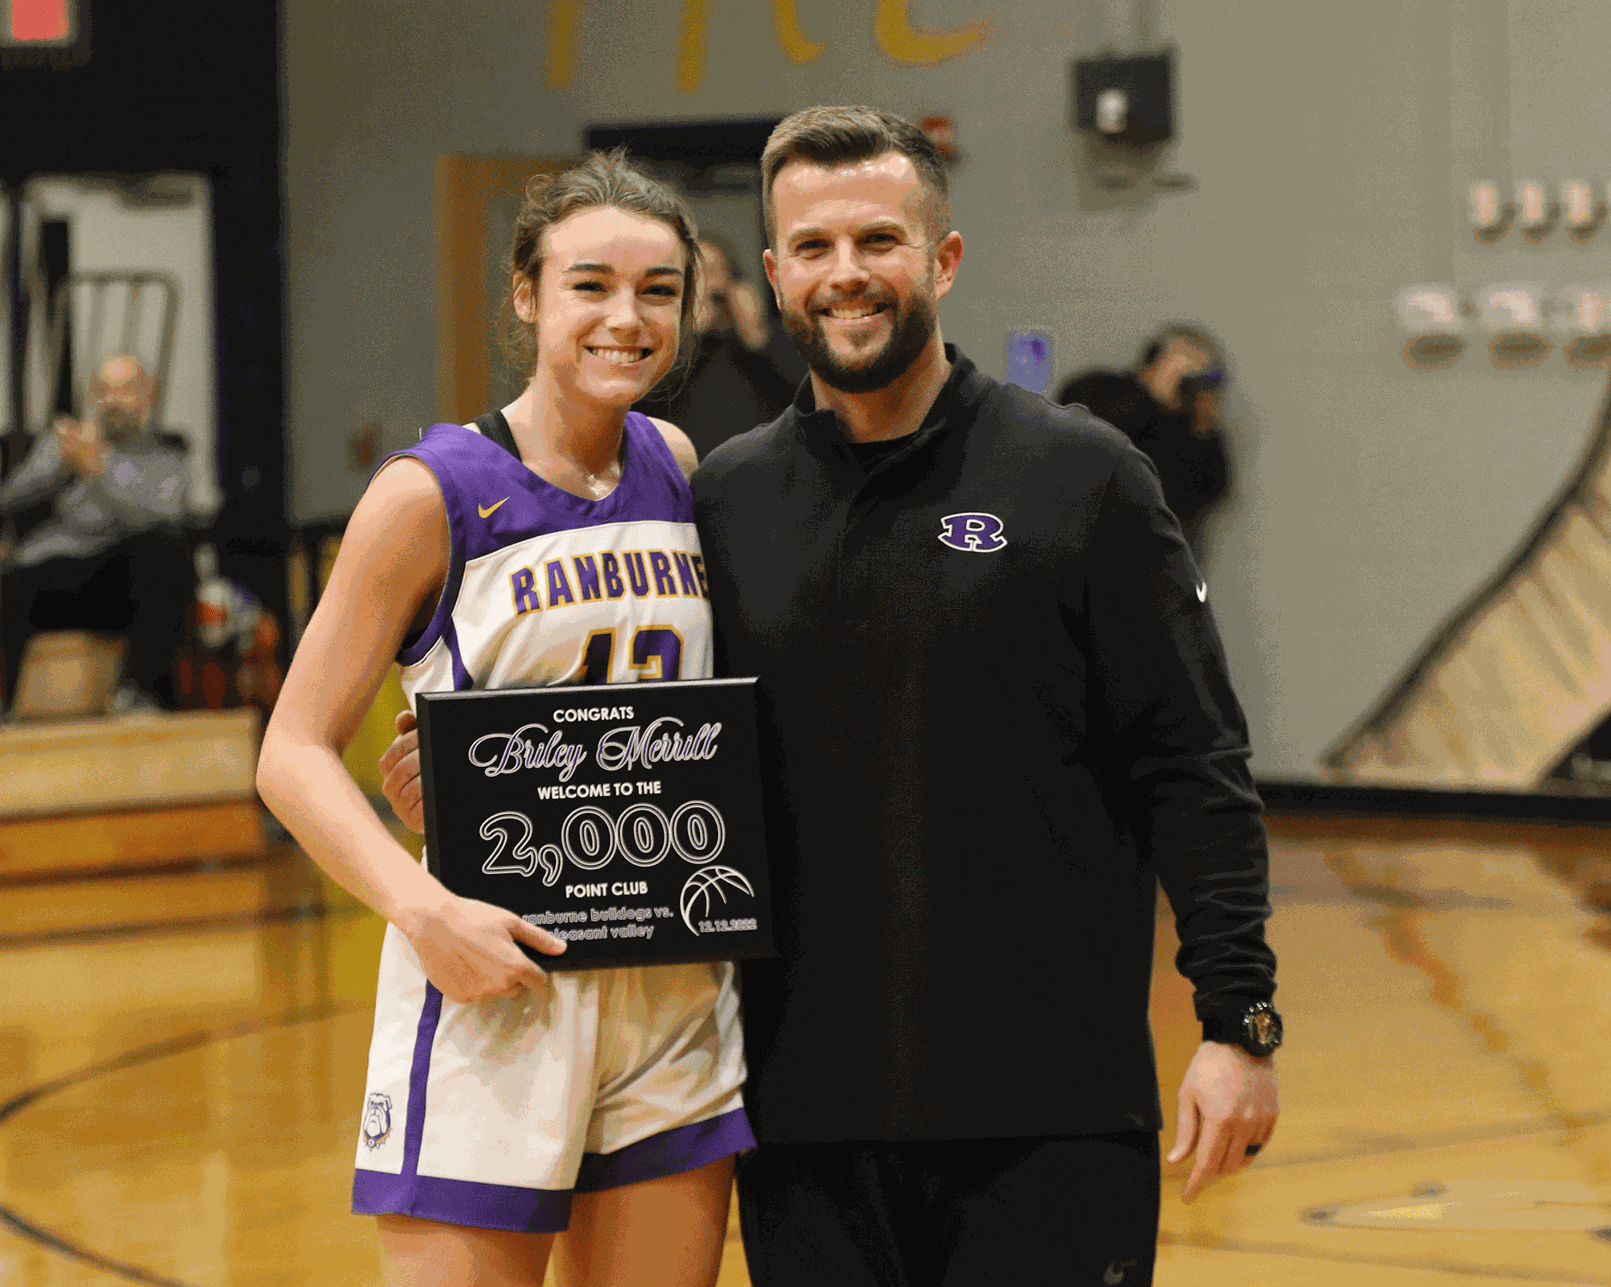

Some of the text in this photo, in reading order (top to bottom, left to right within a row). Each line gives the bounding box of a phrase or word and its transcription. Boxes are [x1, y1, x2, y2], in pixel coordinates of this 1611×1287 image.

[553, 706, 634, 723] CONGRATS
[468, 716, 722, 783] Briley Merrill
[537, 781, 661, 800] WELCOME TO THE
[479, 800, 726, 886] 2,000
[565, 881, 648, 898] POINT CLUB
[590, 906, 652, 922] bulldogs
[549, 924, 654, 941] leasant valley
